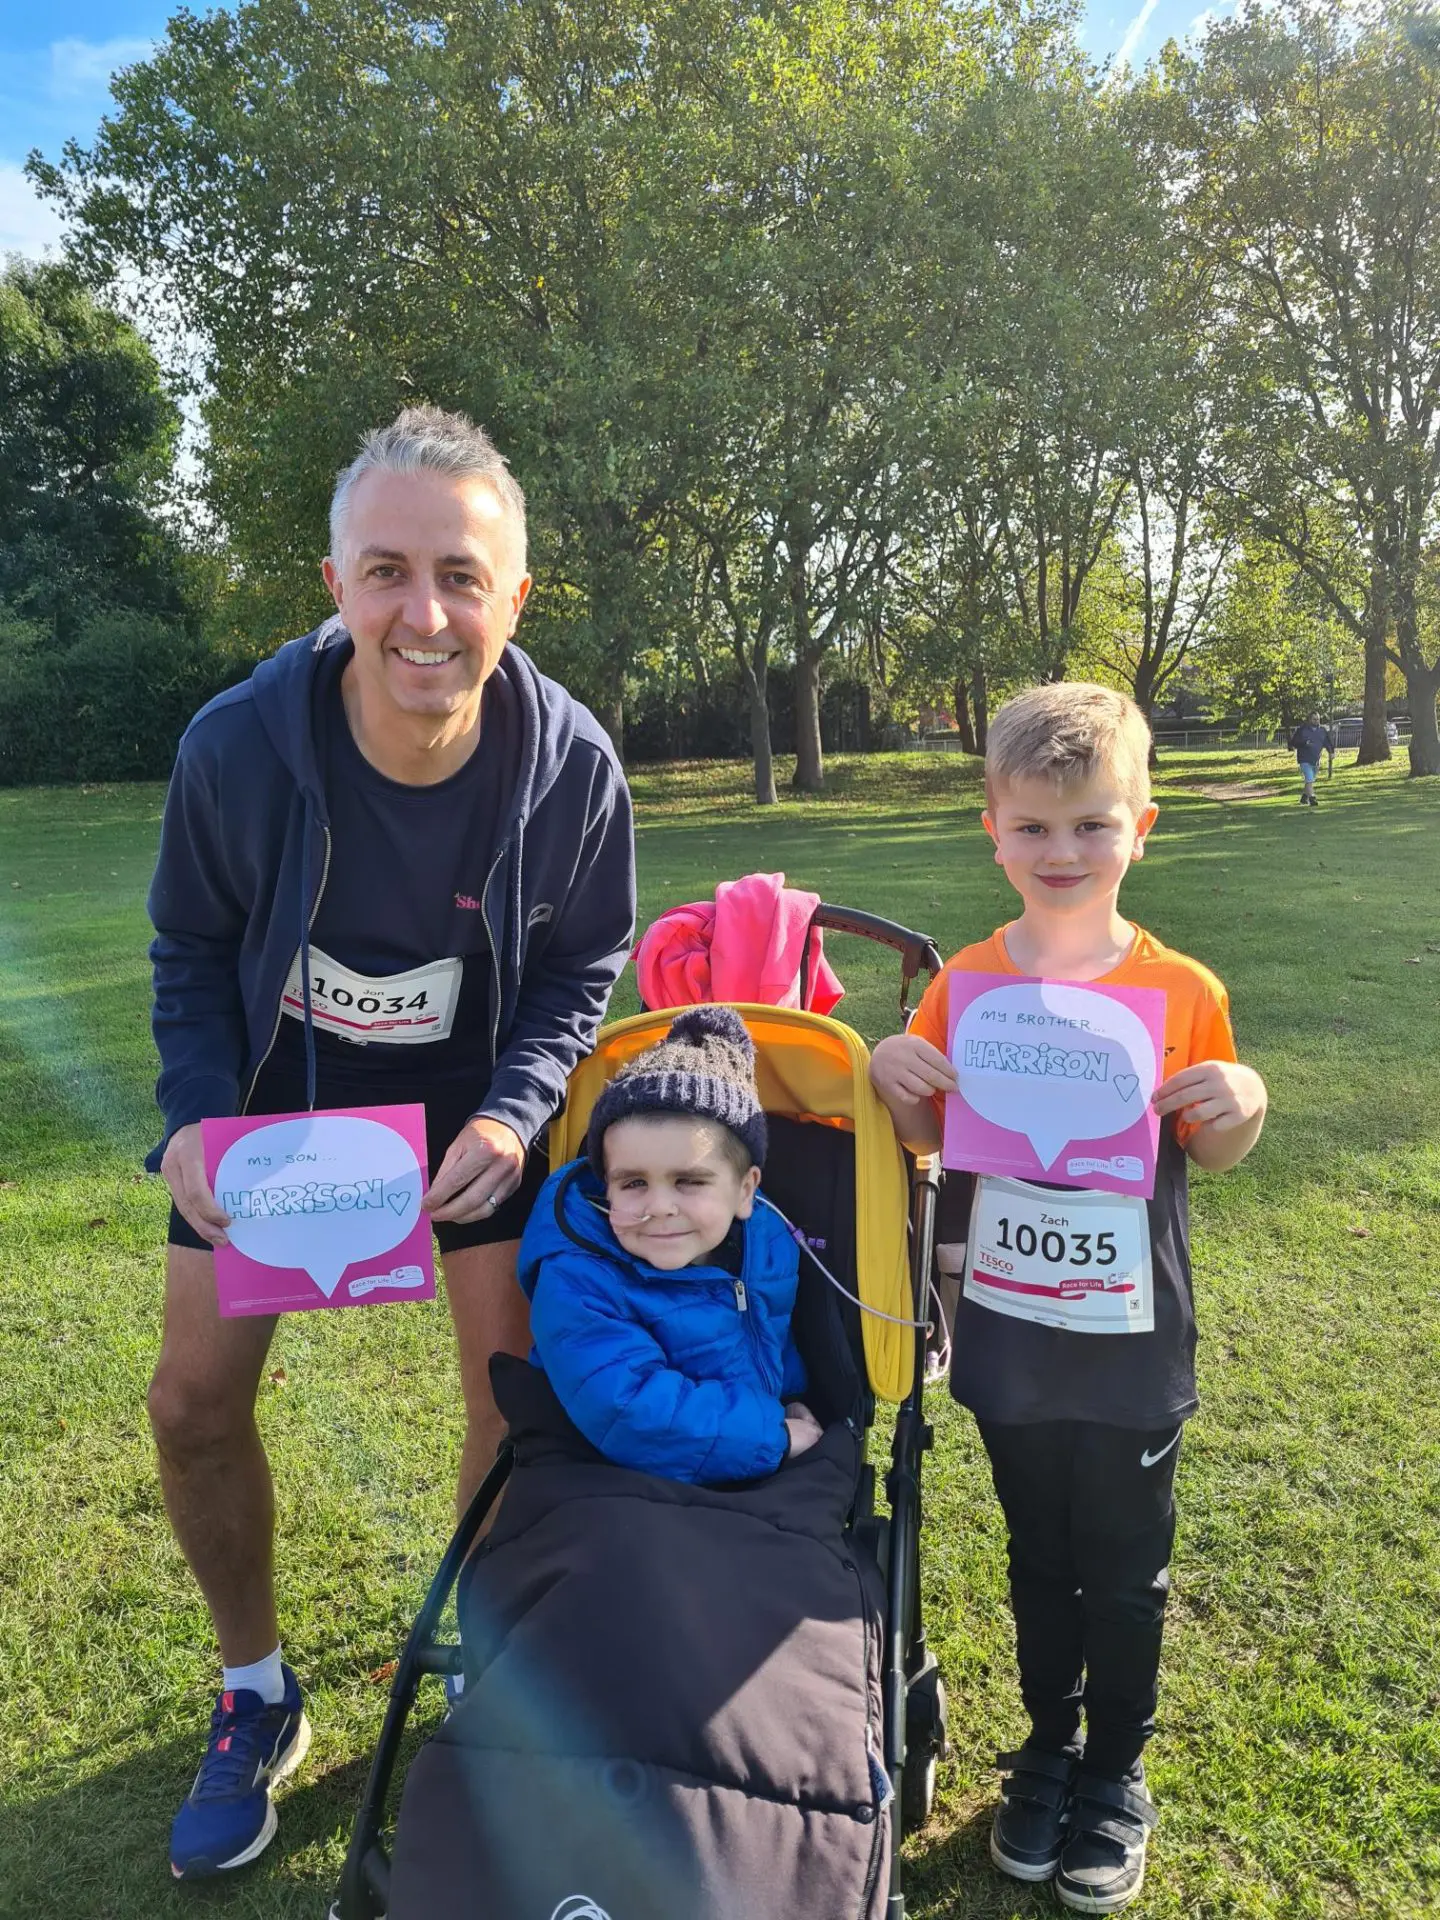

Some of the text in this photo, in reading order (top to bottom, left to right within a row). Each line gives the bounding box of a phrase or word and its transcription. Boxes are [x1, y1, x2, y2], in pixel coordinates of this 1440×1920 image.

[311, 977, 428, 1014] 10034
[1040, 1213, 1069, 1227] Zach
[996, 1218, 1117, 1265] 10035
[980, 1251, 1014, 1271] TESCO
